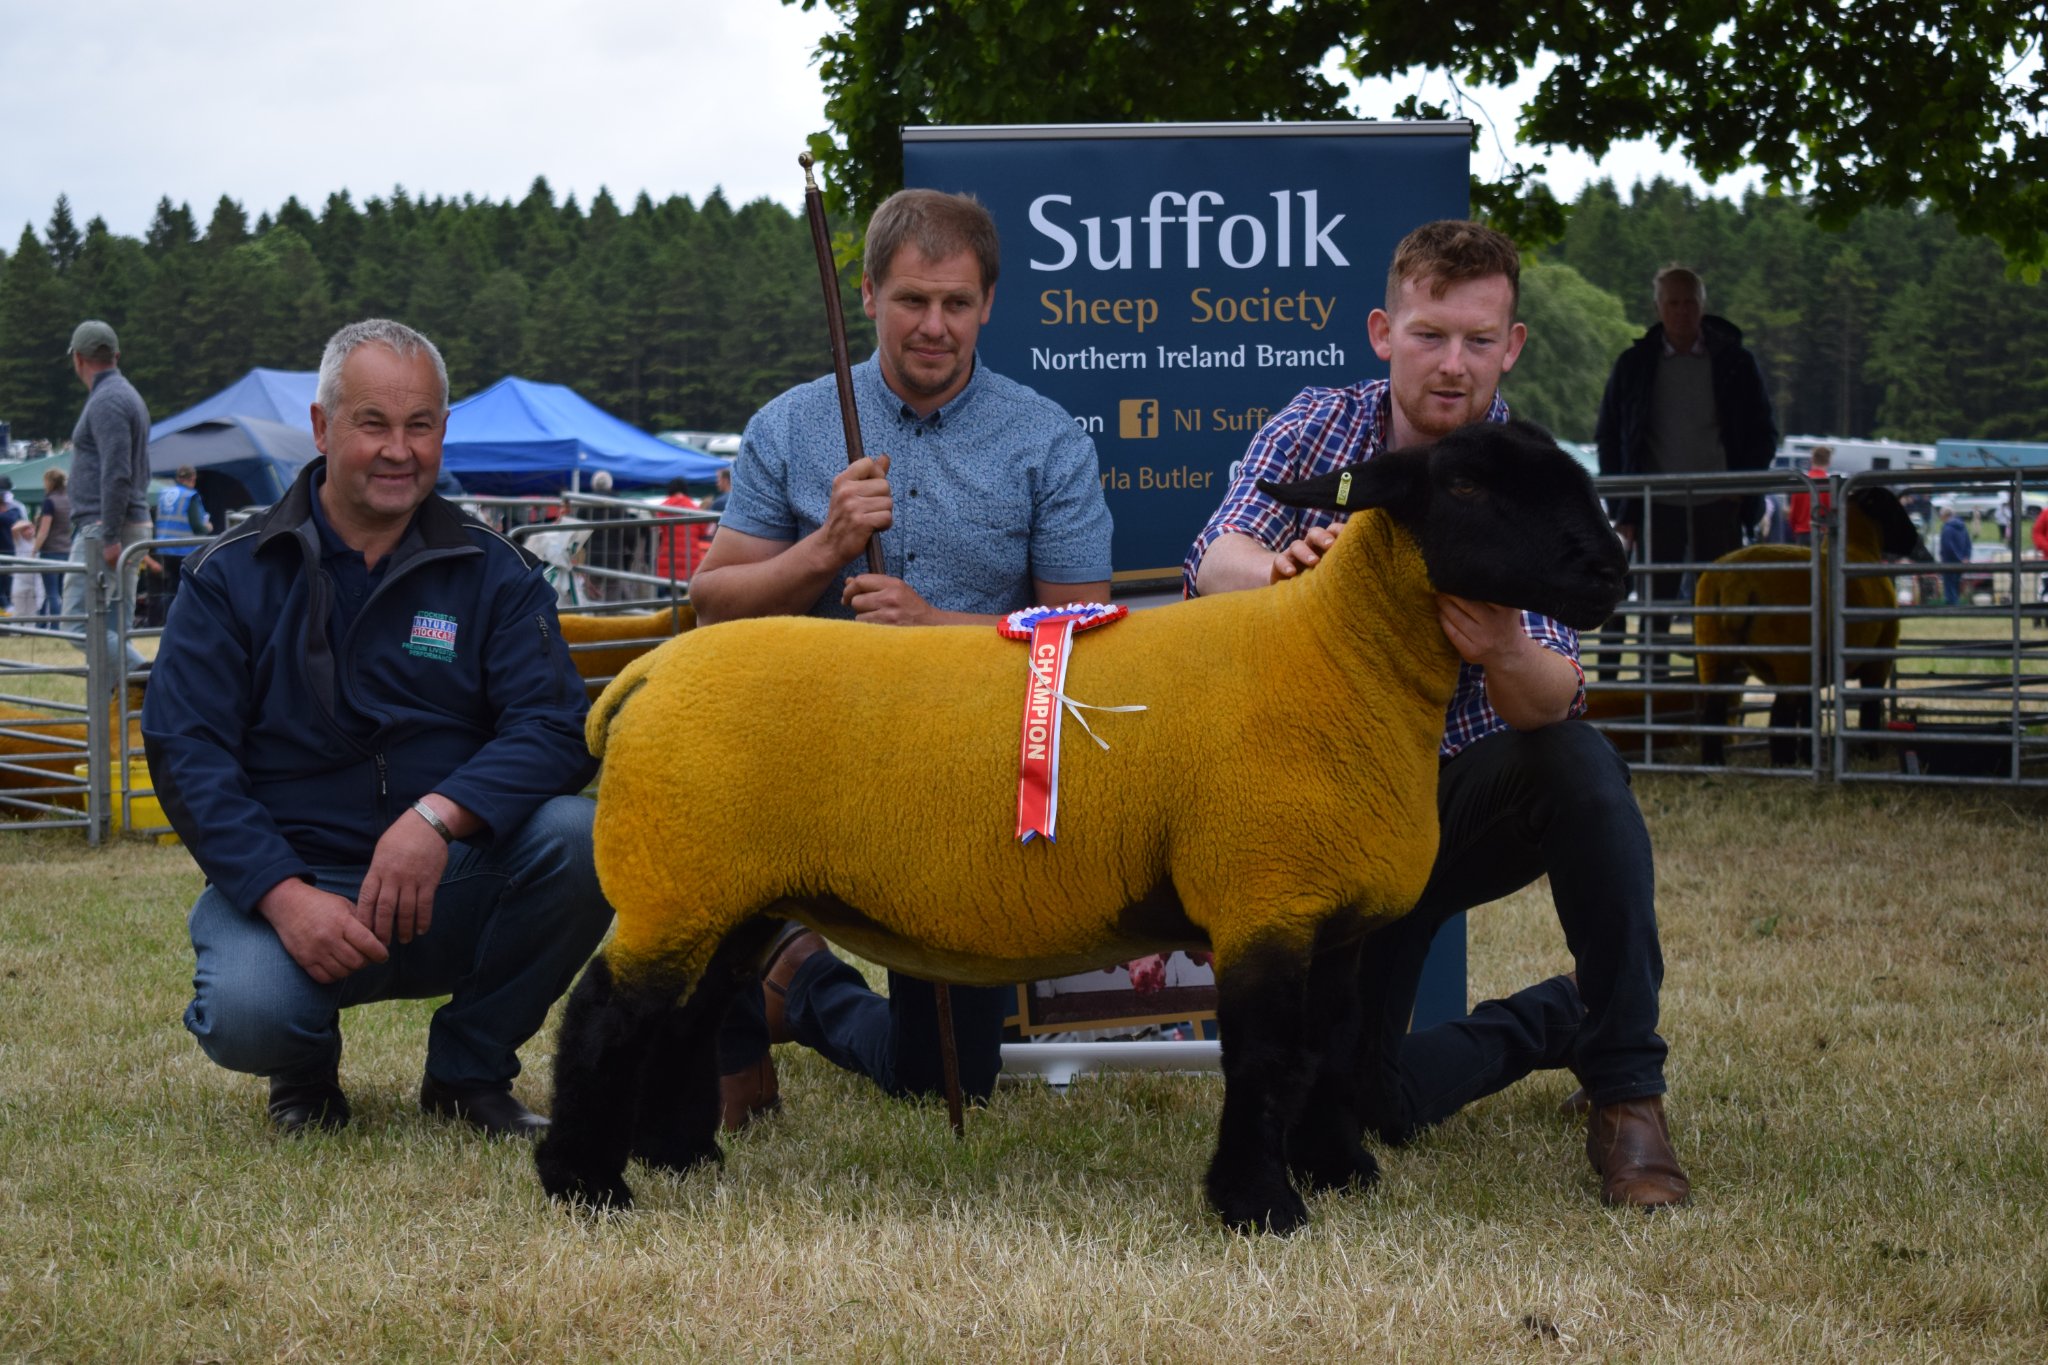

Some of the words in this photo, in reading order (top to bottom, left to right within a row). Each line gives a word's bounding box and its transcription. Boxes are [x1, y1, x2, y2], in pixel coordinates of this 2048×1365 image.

[1029, 189, 1350, 272] Suffolk
[1040, 289, 1159, 332] Sheep
[1191, 287, 1336, 331] Society
[1031, 345, 1147, 371] Northern
[1158, 344, 1246, 369] Ireland
[1257, 343, 1346, 368] Branch
[1212, 407, 1274, 432] Suff
[1100, 465, 1131, 490] rla
[1139, 465, 1215, 490] Butler
[415, 618, 456, 633] NATURAL
[1027, 643, 1056, 760] CHAMPION
